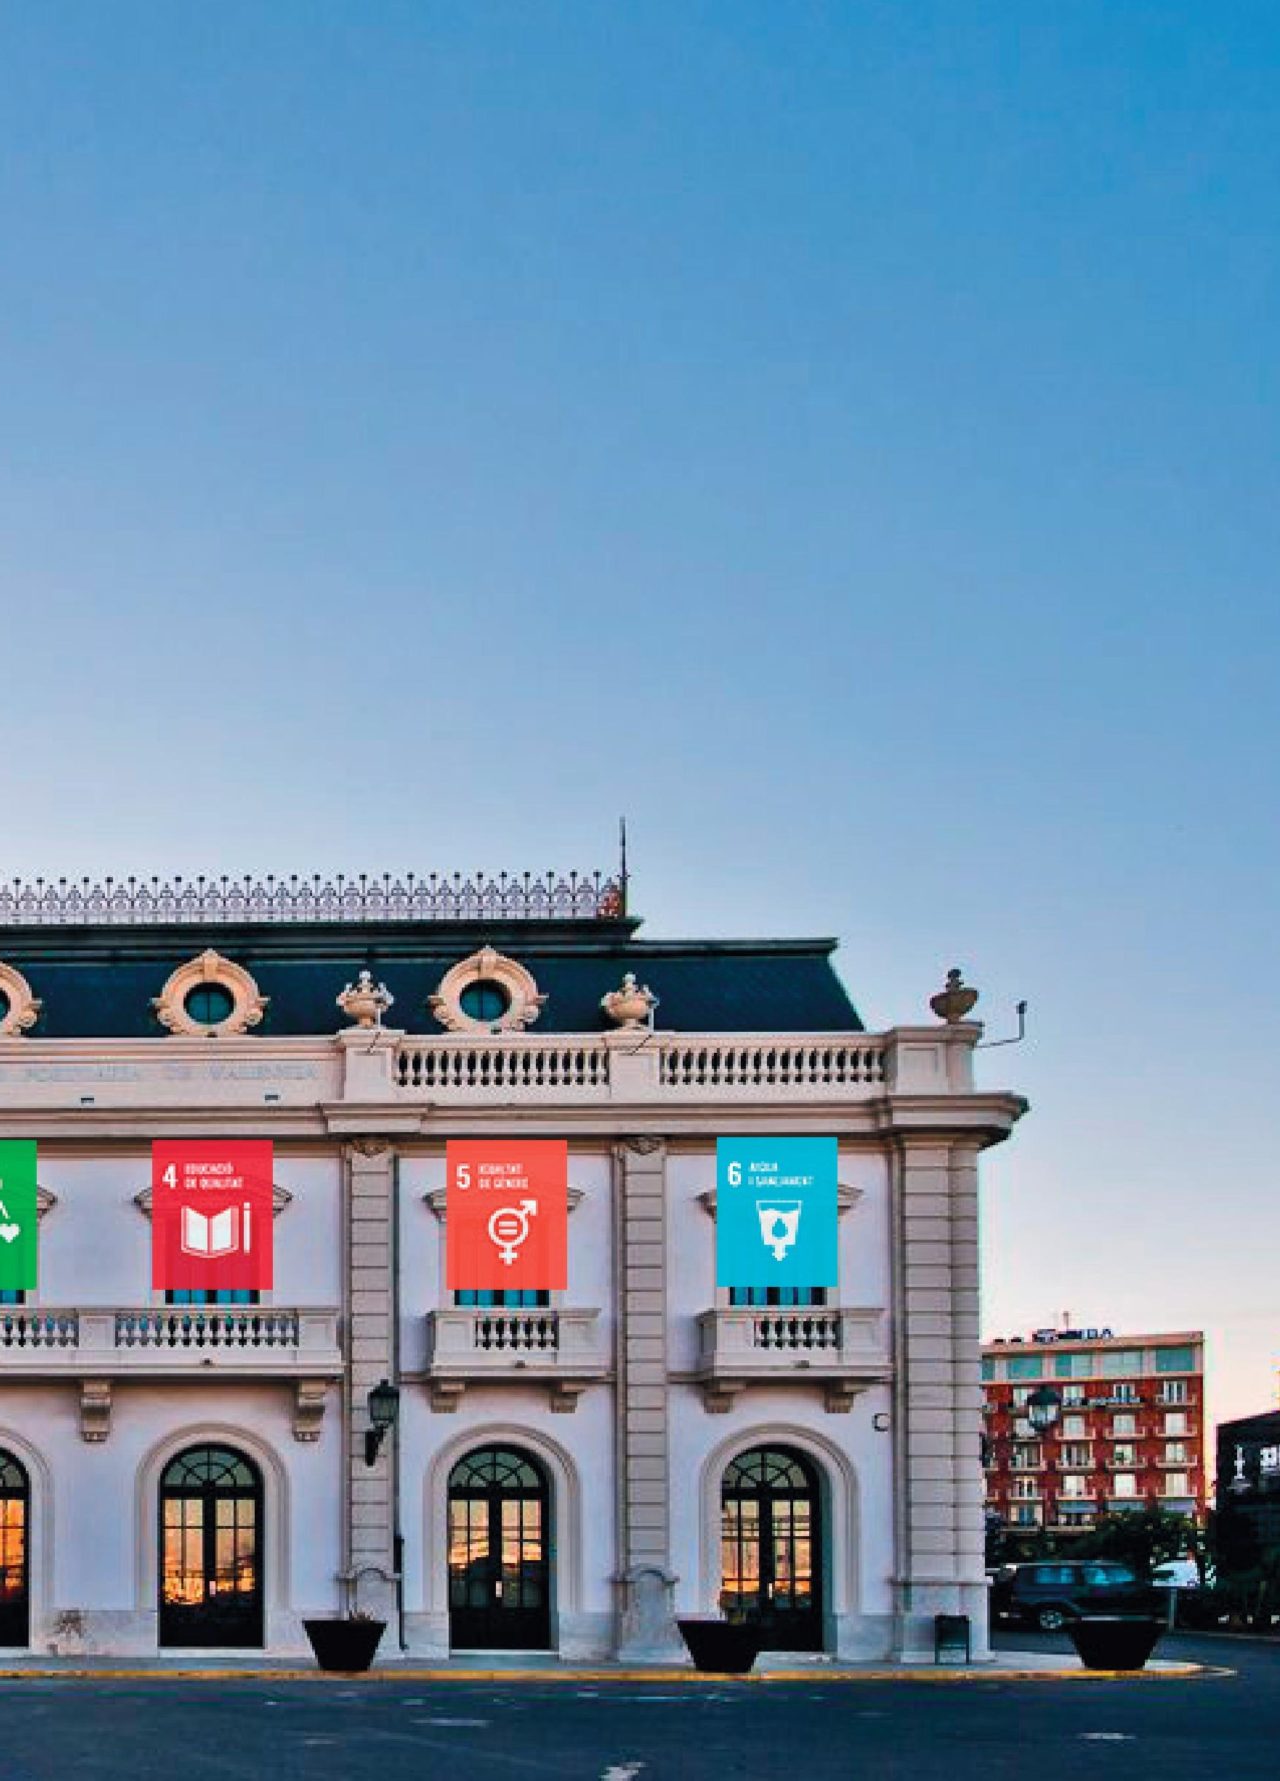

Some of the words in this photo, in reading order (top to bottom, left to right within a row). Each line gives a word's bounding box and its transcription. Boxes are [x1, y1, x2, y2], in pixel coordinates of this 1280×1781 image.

[162, 1163, 179, 1189] 4
[456, 1163, 470, 1189] 5
[727, 1160, 742, 1187] 6
